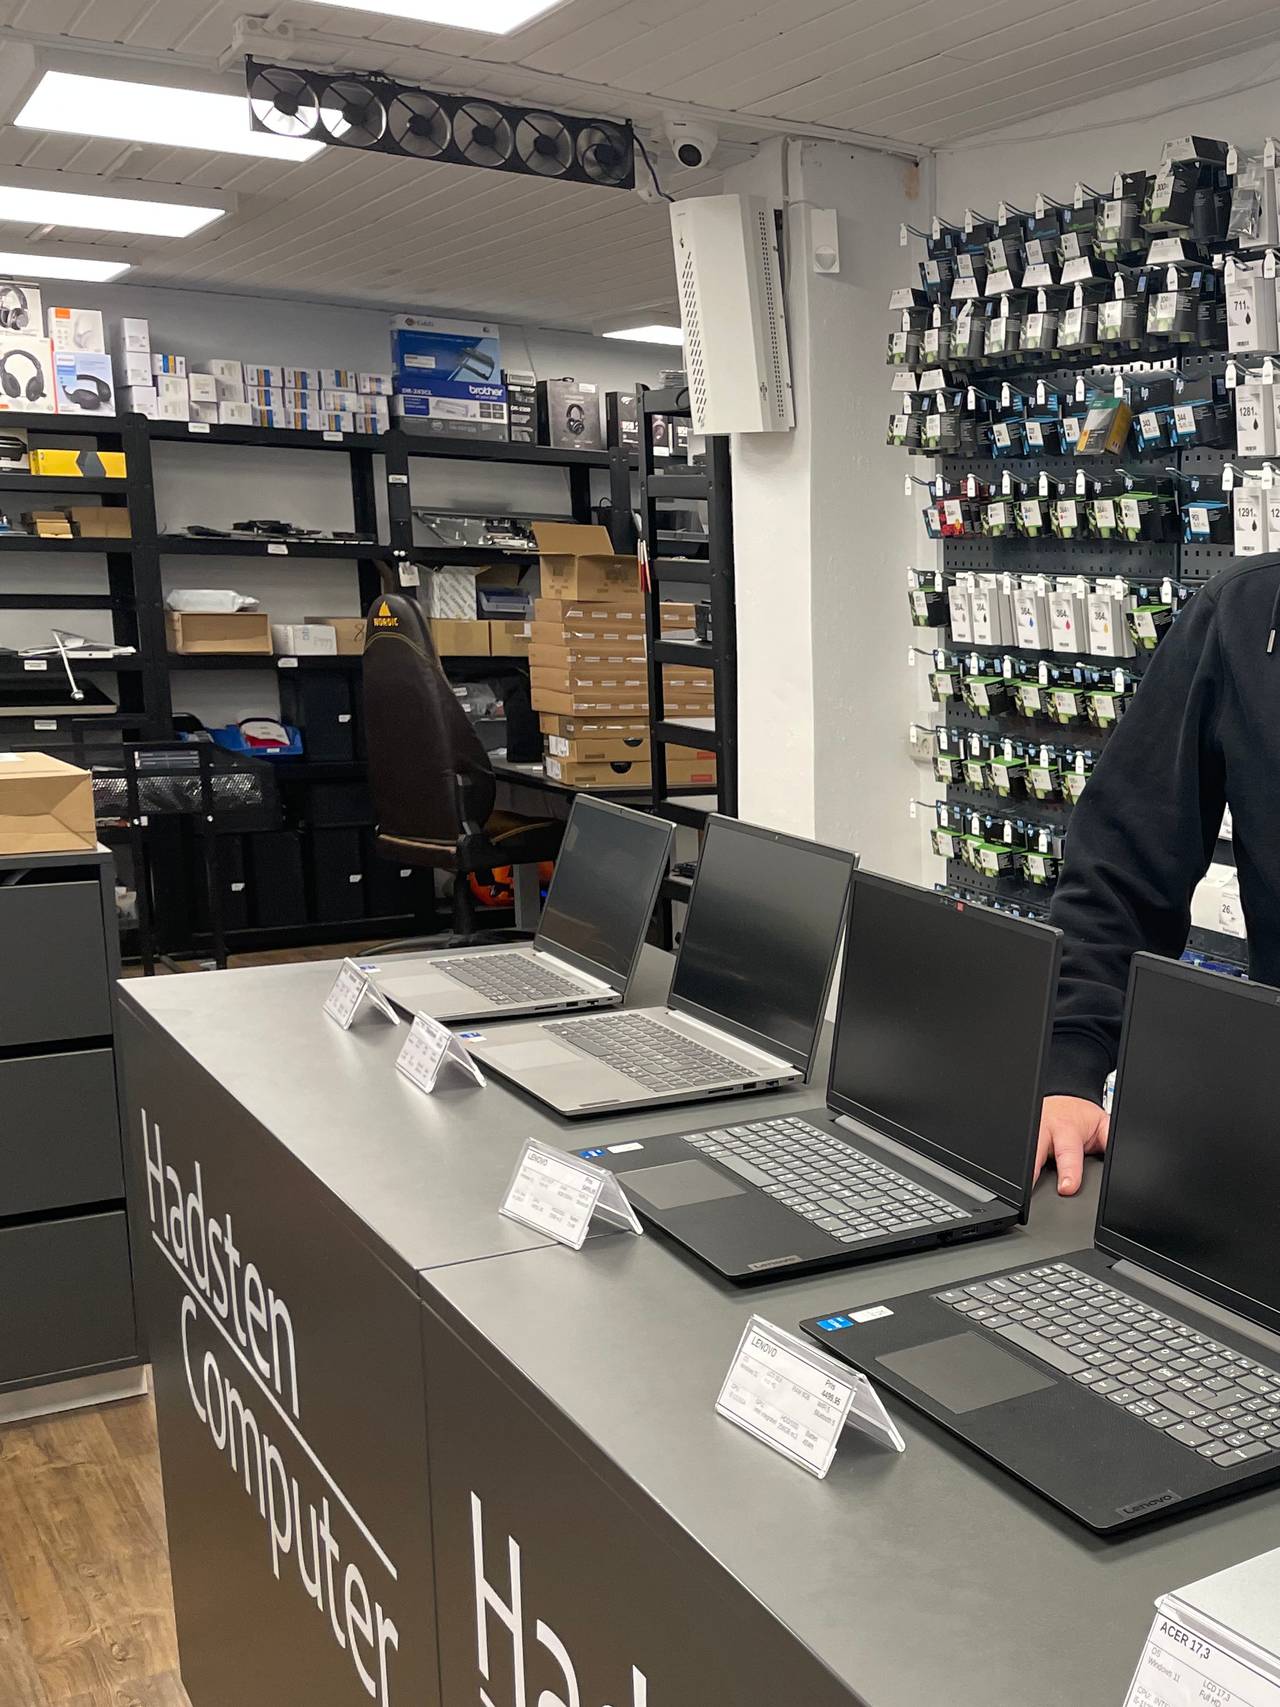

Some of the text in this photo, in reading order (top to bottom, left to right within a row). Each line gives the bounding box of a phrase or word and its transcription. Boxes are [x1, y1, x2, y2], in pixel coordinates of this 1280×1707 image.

[469, 385, 503, 397] brother
[140, 1107, 300, 1420] Hadsten
[751, 1335, 777, 1357] LENOVO
[181, 1294, 399, 1707] Computer
[1123, 1491, 1173, 1516] Lenovo
[1160, 1621, 1211, 1660] ACER 17,3
[1147, 1657, 1172, 1679] Windows
[1203, 1679, 1215, 1692] LCD
